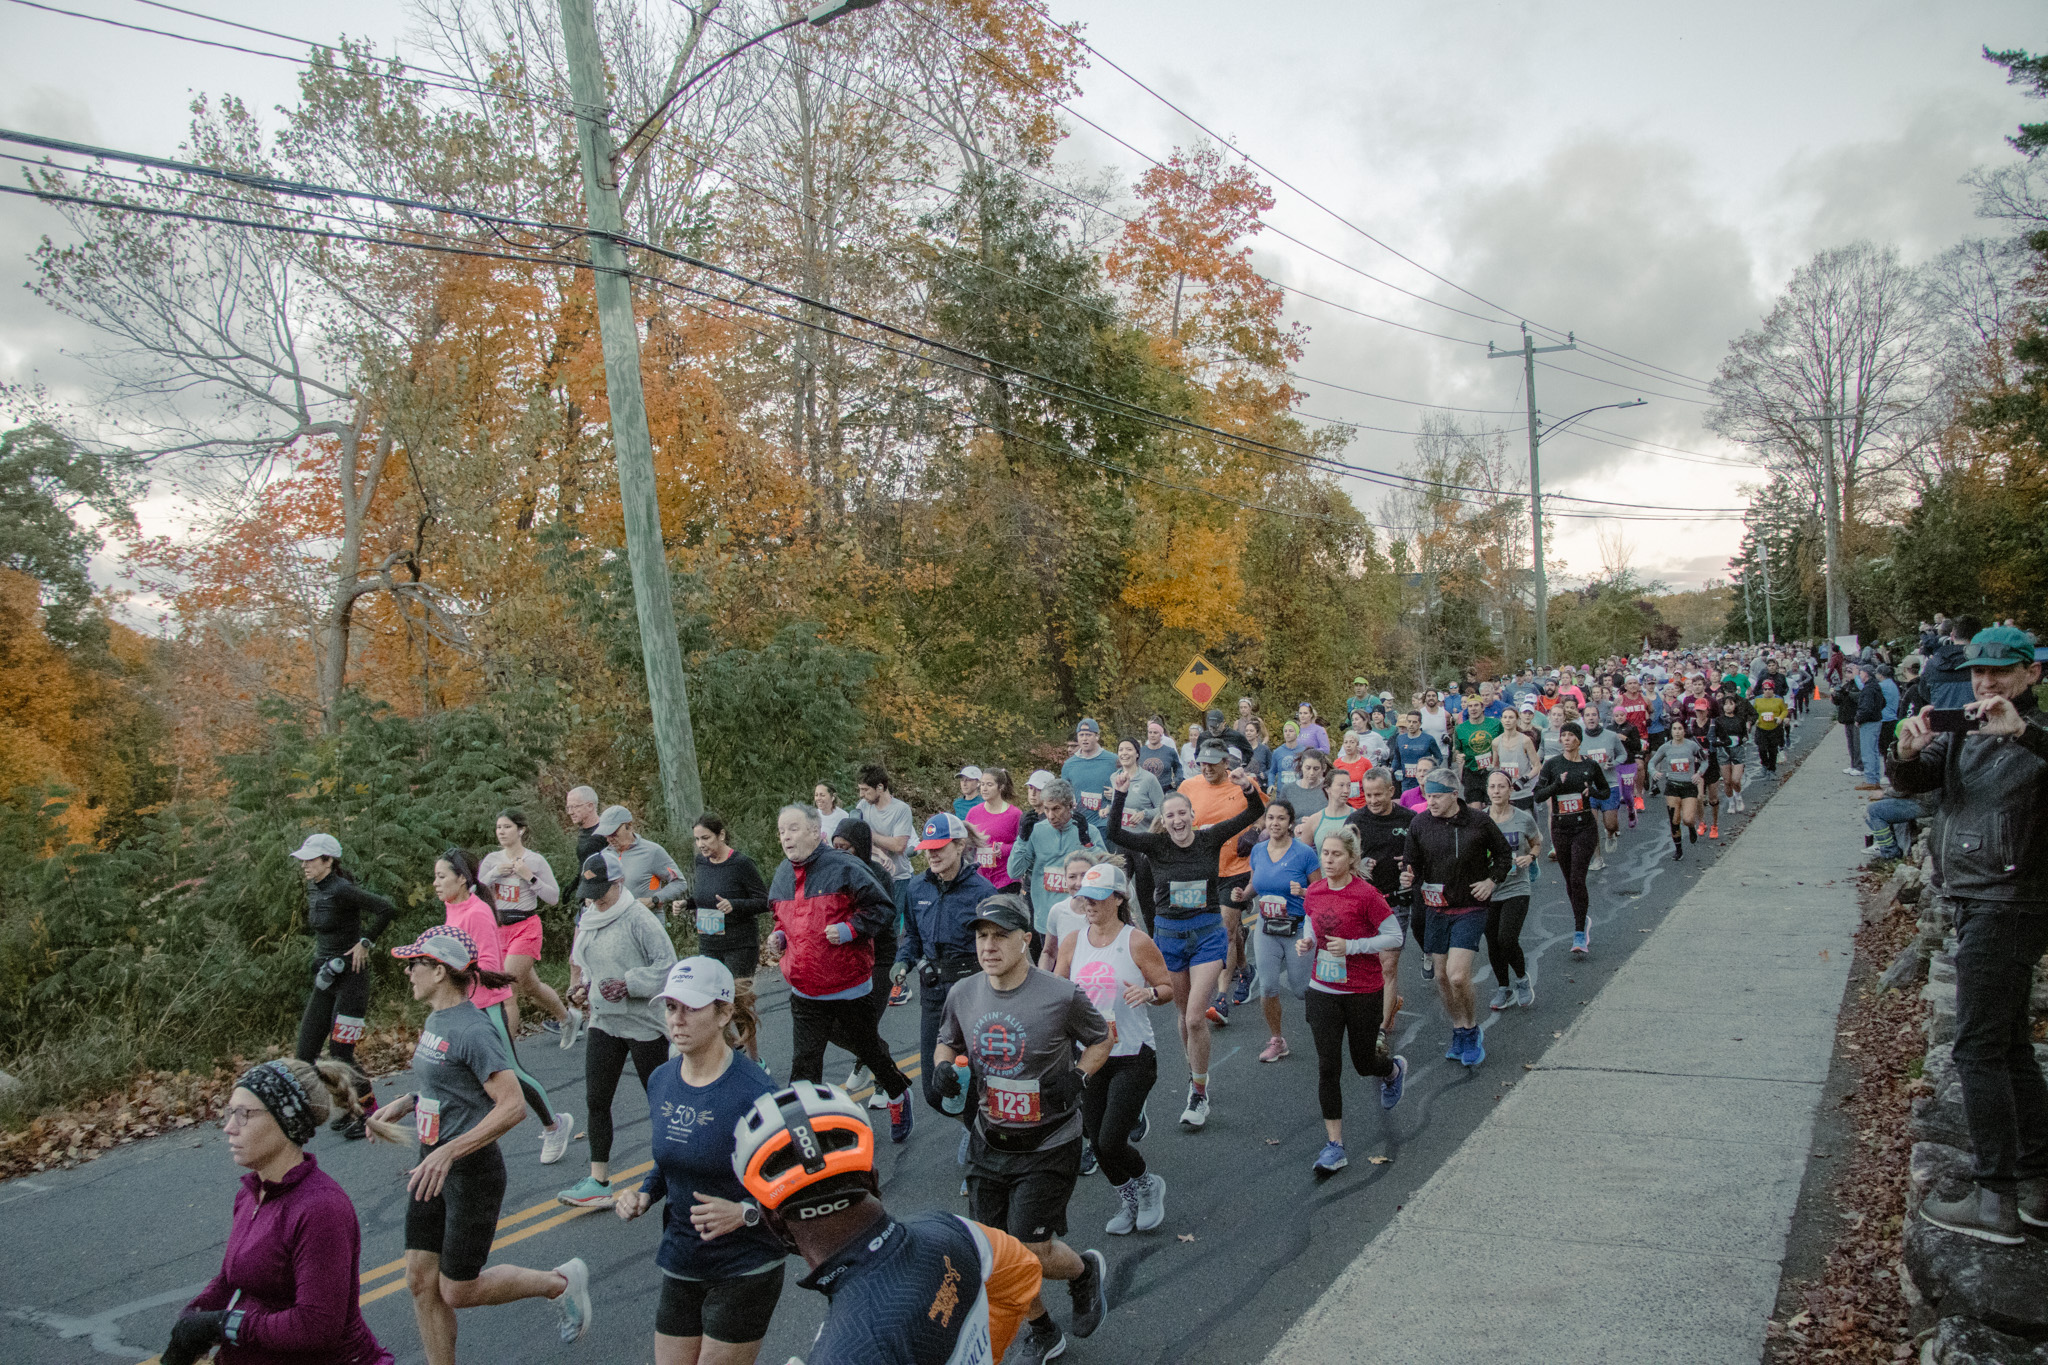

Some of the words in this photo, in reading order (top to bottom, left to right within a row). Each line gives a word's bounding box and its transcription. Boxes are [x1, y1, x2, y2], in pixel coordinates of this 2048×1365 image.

[1082, 798, 1099, 809] 469
[1562, 800, 1578, 811] 113
[1175, 890, 1202, 904] 632
[1424, 891, 1442, 904] 423
[1264, 902, 1282, 916] 414
[700, 917, 720, 931] 706
[336, 1024, 362, 1040] 226
[973, 1011, 1003, 1035] STAYIN'
[1004, 1014, 1027, 1040] ALIVE
[994, 1091, 1030, 1116] 123
